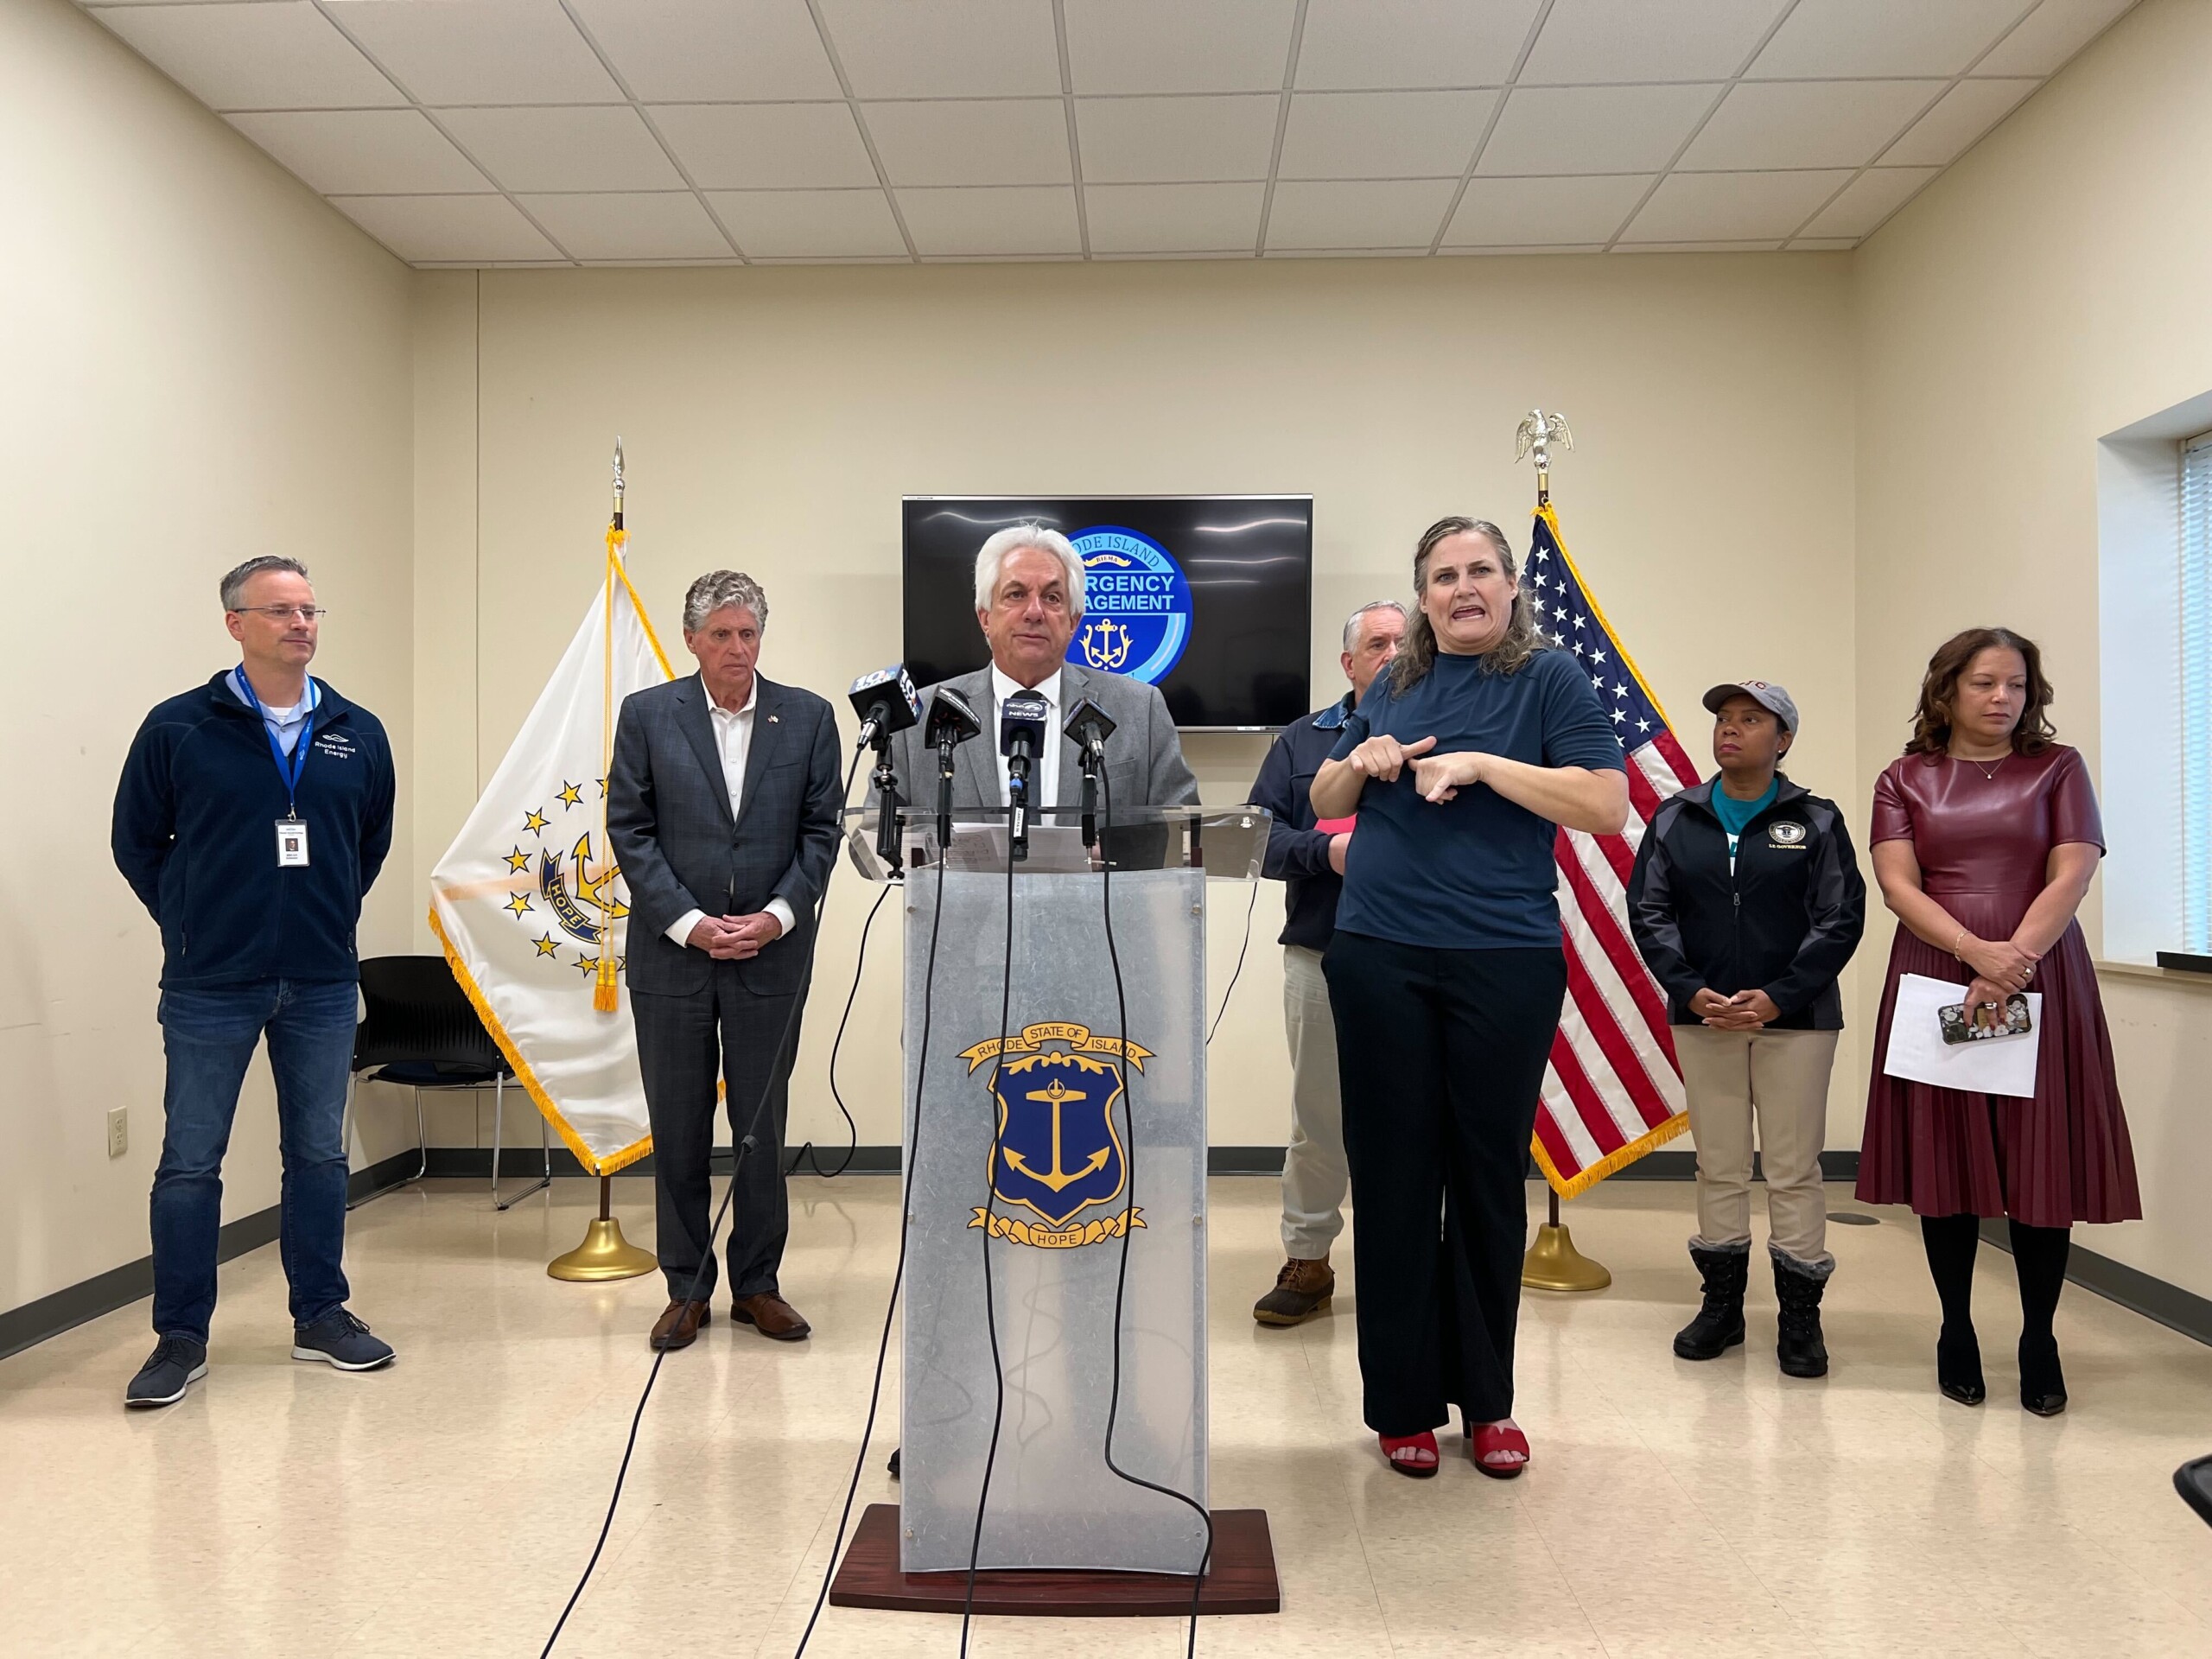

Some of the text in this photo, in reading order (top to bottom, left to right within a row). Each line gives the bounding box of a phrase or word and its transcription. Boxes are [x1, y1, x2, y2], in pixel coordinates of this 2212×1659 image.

[1071, 536, 1160, 568] ODE ISLAND
[1085, 575, 1174, 592] RGENCY
[1084, 594, 1174, 610] AGEMENT
[856, 670, 886, 688] 10
[901, 668, 917, 700] 10
[315, 741, 356, 753] Rhode Island
[324, 748, 348, 760] Energy
[551, 884, 582, 925] HOPE
[1030, 1026, 1084, 1039] STATE OF
[977, 1039, 1024, 1058] RHODE
[1037, 1234, 1077, 1245] HOPE
